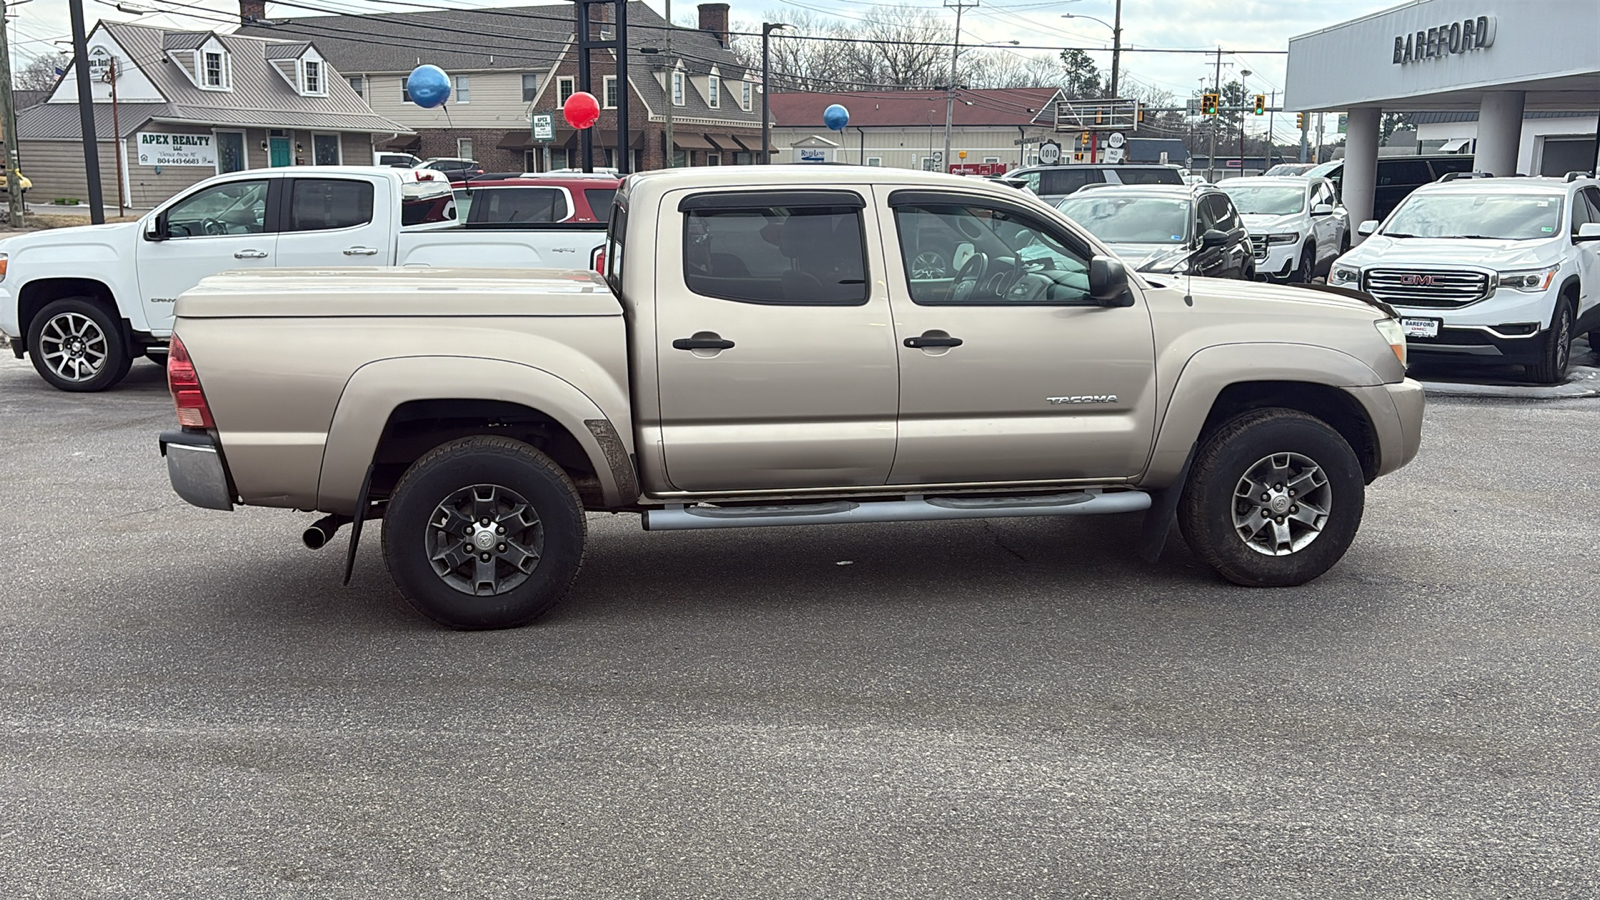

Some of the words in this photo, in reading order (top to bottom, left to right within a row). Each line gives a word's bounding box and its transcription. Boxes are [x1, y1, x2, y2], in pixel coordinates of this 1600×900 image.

[1393, 15, 1490, 64] BAREFORD
[142, 134, 170, 145] APEX
[172, 135, 210, 146] REALTY
[1042, 149, 1057, 158] 1010
[1401, 274, 1445, 286] GMC
[1046, 395, 1119, 405] TACOMA
